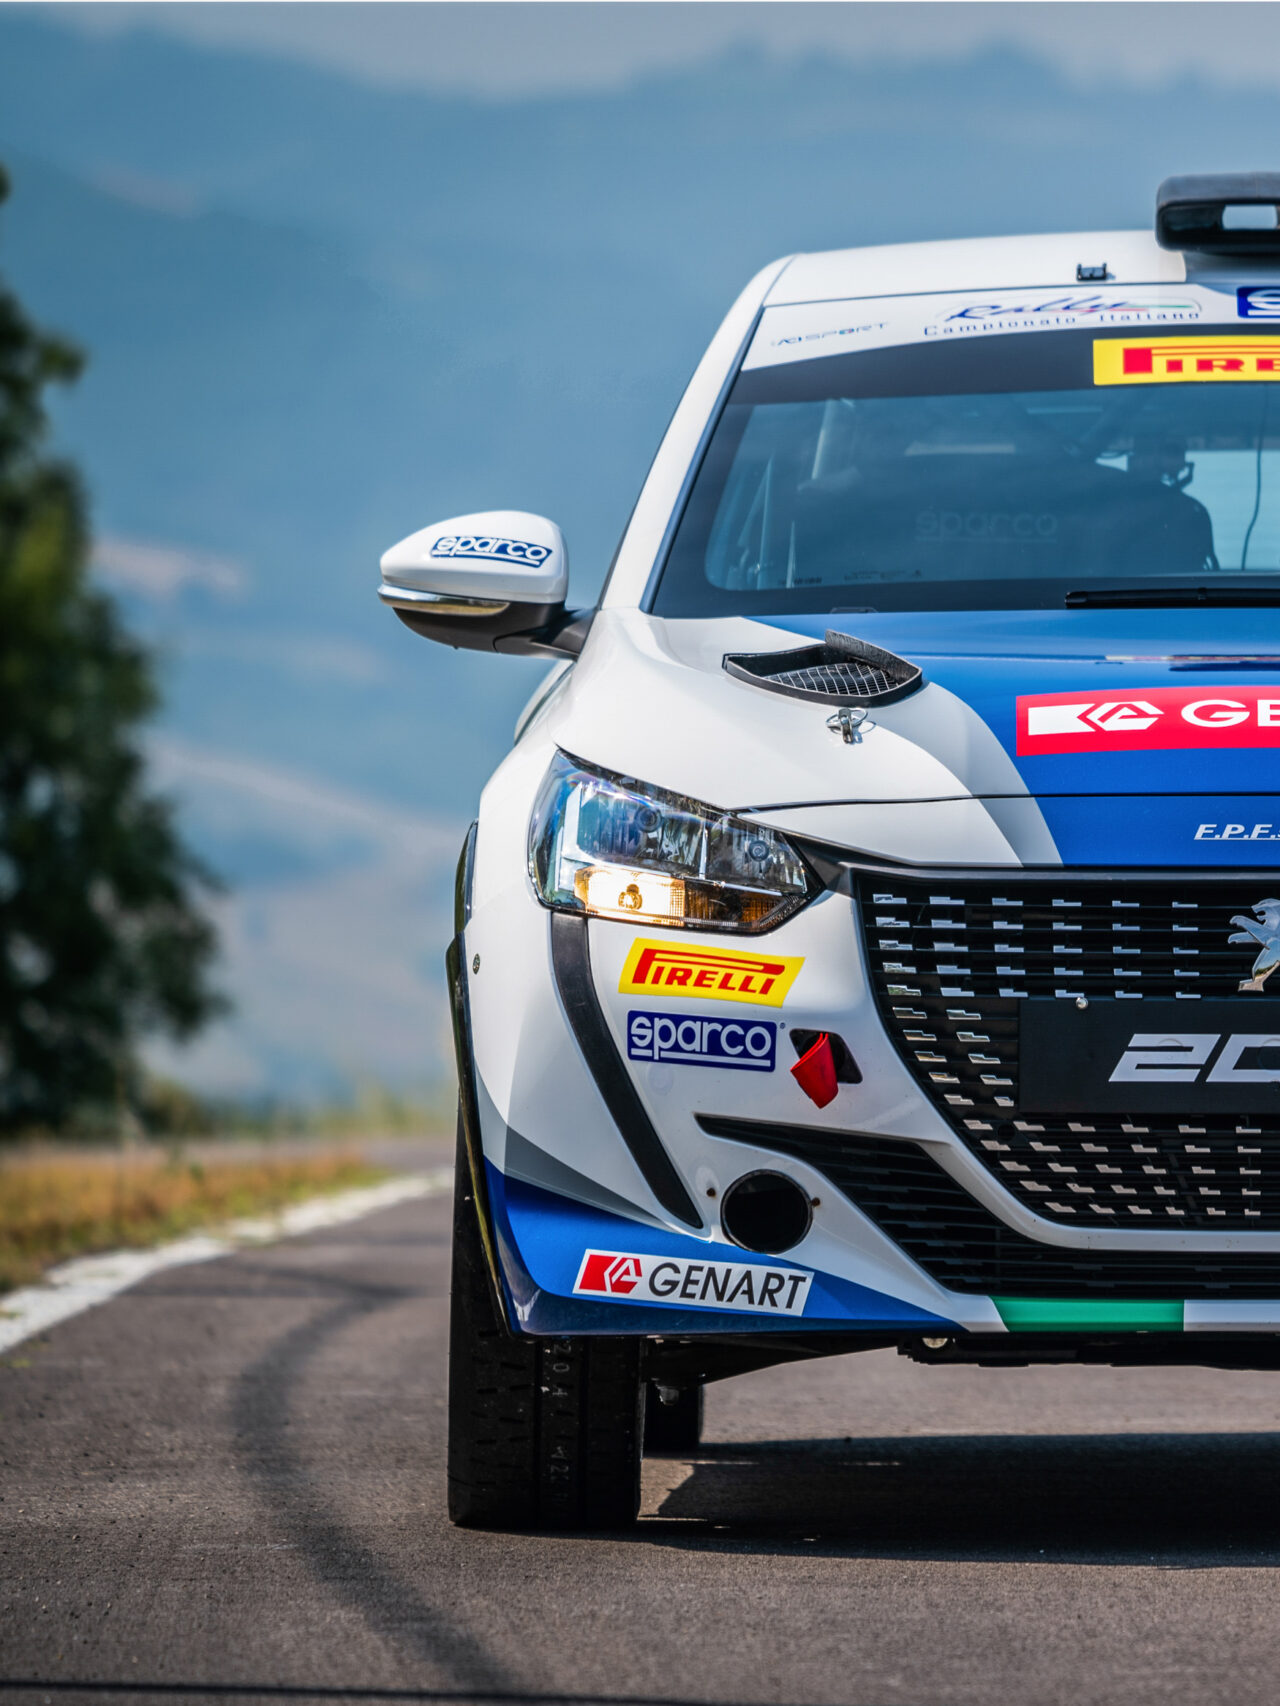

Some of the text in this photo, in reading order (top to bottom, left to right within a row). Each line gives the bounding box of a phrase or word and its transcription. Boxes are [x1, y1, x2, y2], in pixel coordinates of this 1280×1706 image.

[923, 311, 1200, 336] Campionato Italiano
[914, 510, 1059, 543] sparco
[434, 536, 548, 563] sparco
[631, 948, 786, 995] PIRELLI
[630, 1016, 772, 1061] sparco
[649, 1262, 807, 1309] GENART
